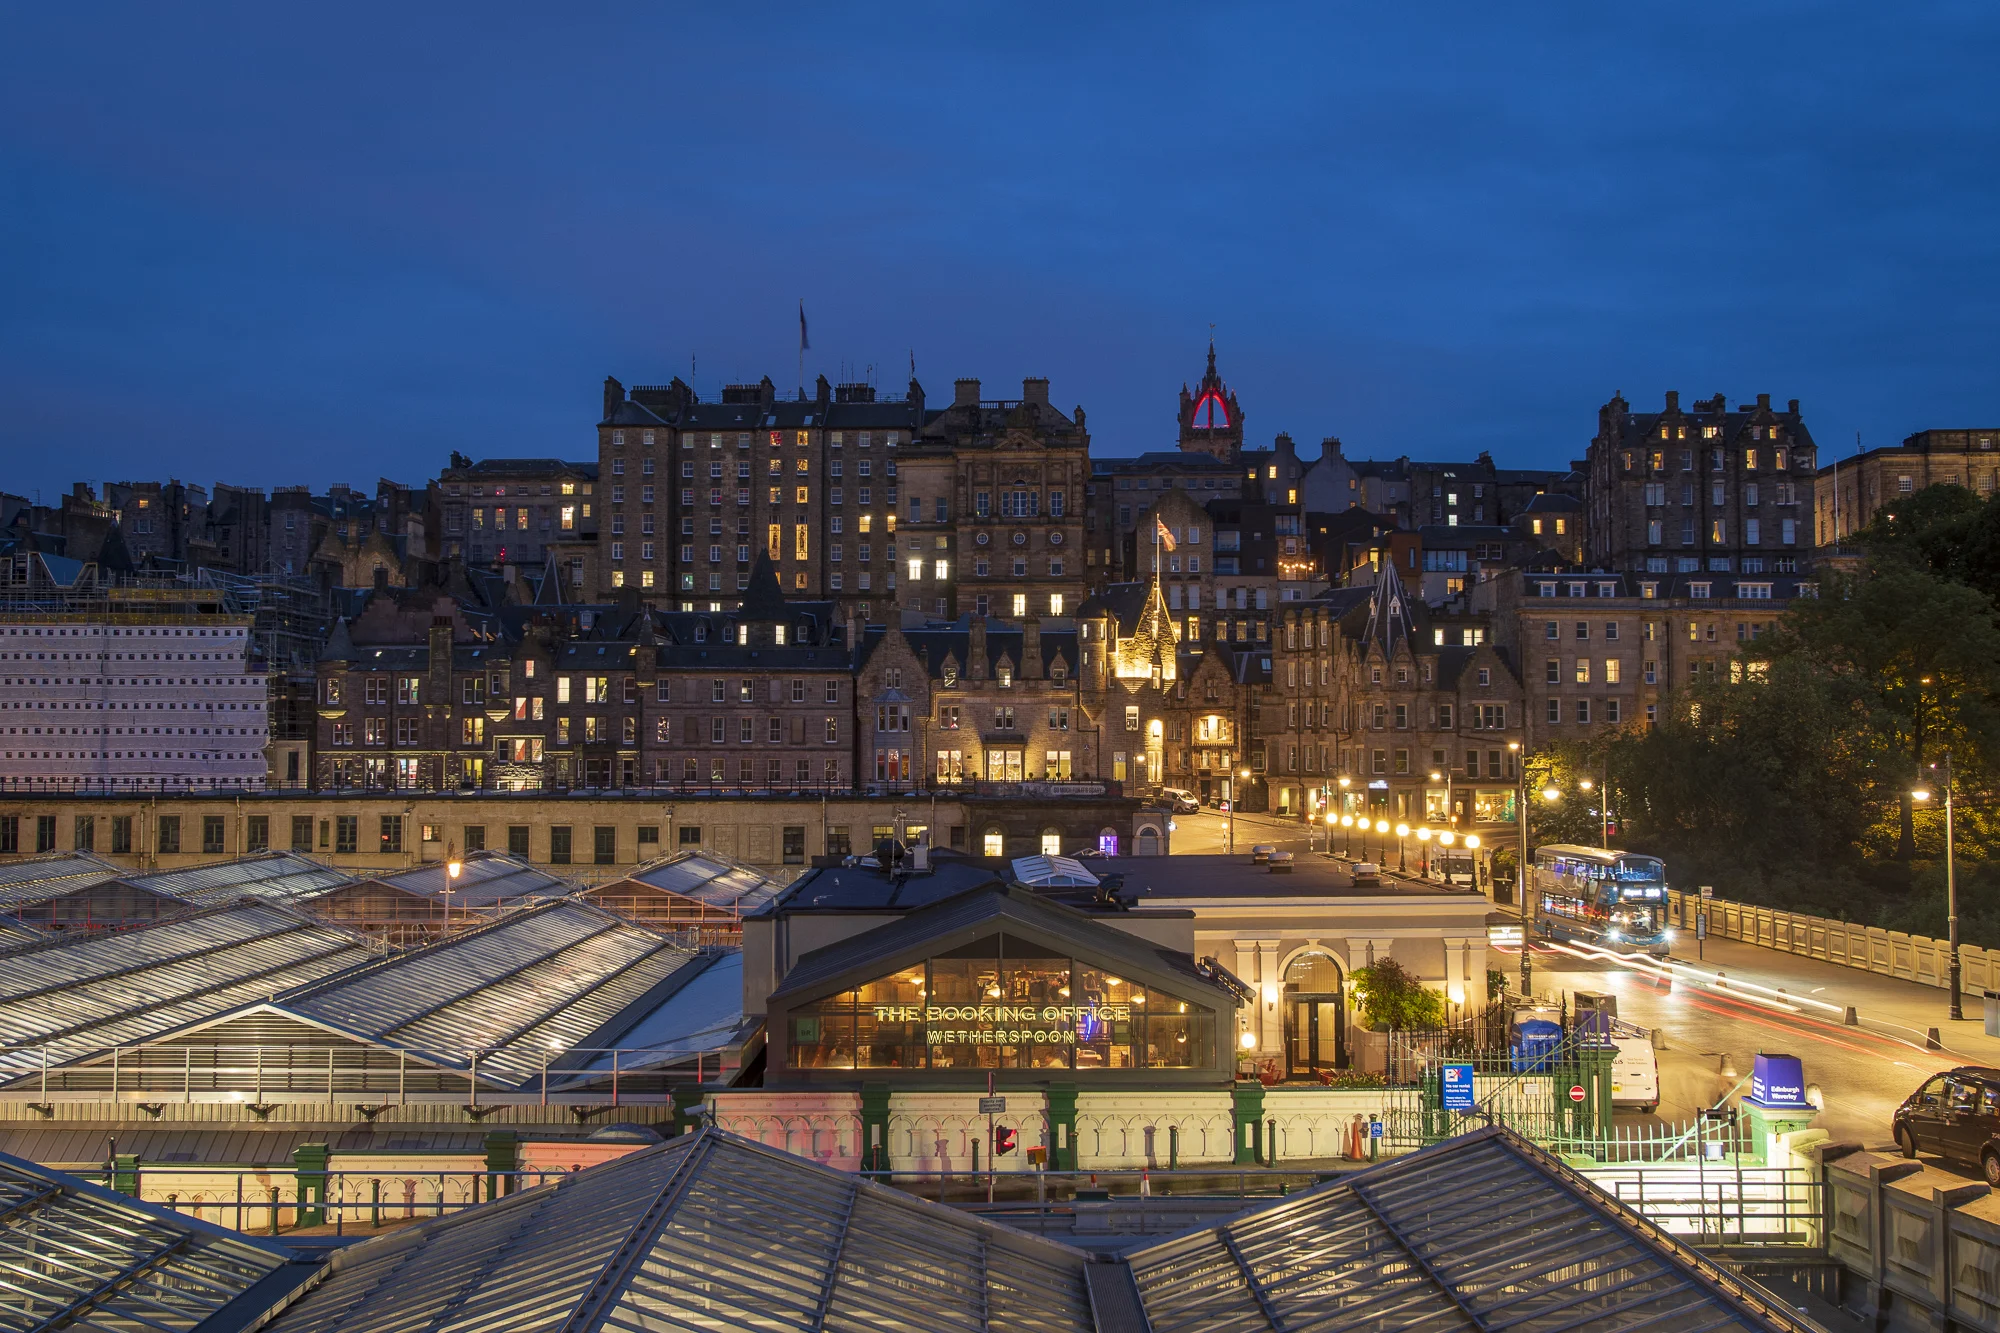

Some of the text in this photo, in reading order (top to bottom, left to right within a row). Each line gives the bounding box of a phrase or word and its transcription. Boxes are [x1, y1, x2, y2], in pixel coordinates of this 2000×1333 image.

[873, 1006, 1131, 1022] THE BOOKING OFFICE
[927, 1030, 1075, 1044] WETHERSPOON
